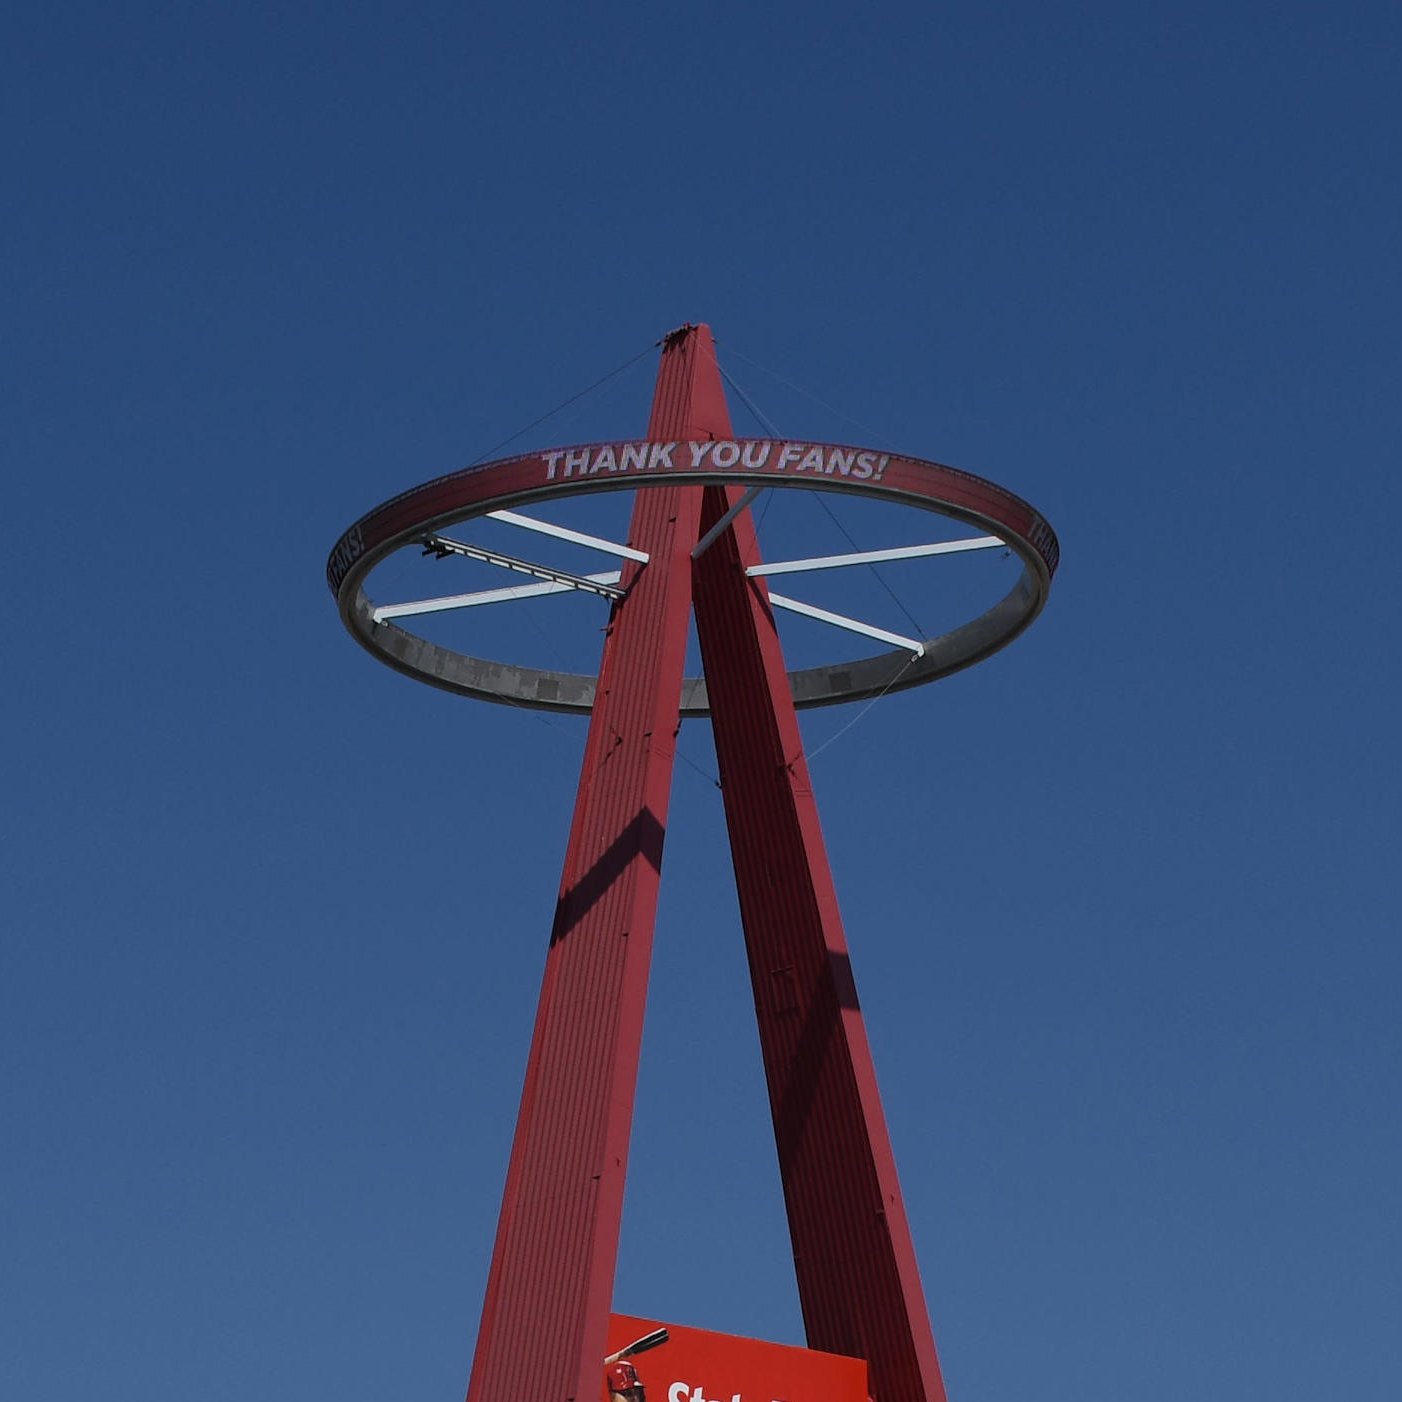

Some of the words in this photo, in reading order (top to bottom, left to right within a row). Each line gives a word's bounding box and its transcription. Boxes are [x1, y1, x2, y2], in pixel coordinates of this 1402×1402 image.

[541, 441, 678, 481] THANK
[688, 440, 771, 469] YOU
[777, 442, 890, 482] FANS!
